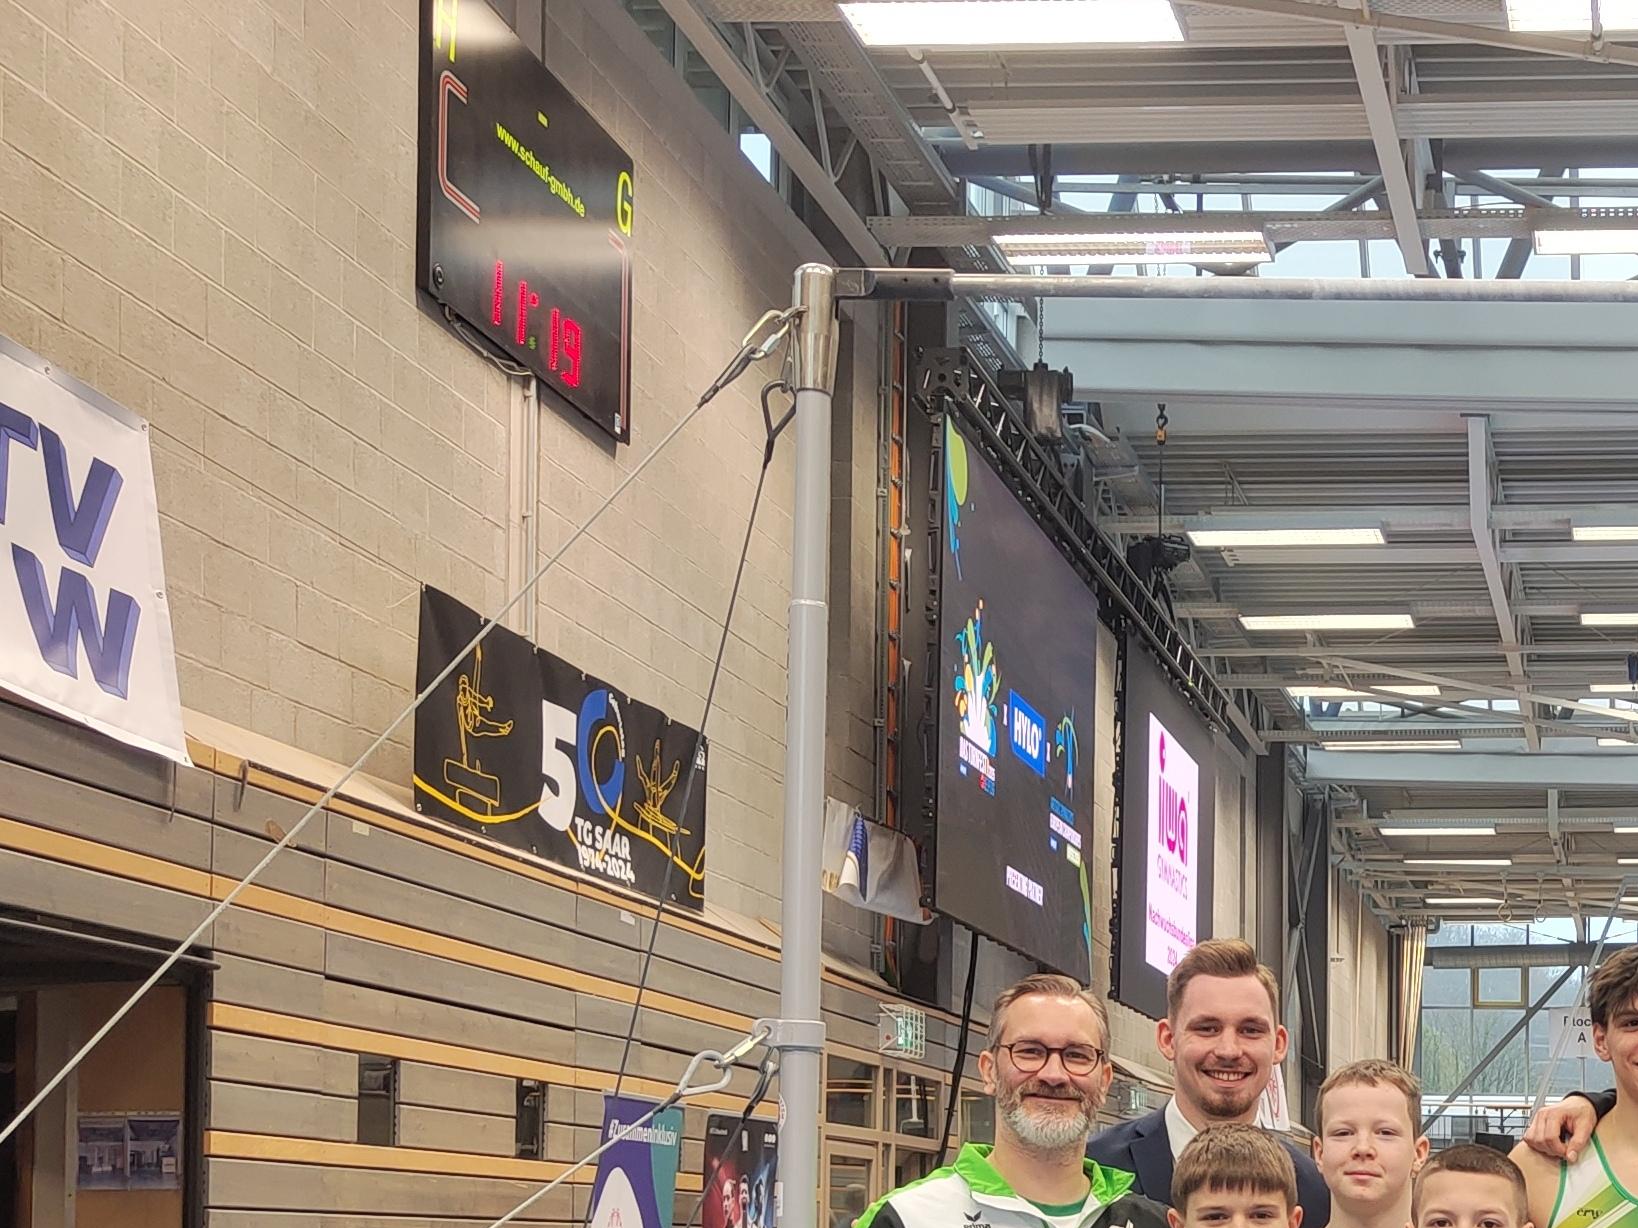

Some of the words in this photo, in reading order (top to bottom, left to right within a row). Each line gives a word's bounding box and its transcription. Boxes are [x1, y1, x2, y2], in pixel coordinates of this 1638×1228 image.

[495, 122, 586, 218] www.schauf-gmbh.de
[616, 171, 633, 237] G
[1013, 706, 1041, 760] HYLO
[575, 816, 593, 844] TG
[594, 826, 632, 860] SAAR
[577, 844, 636, 884] 1974-2024
[1577, 1031, 1586, 1043] A
